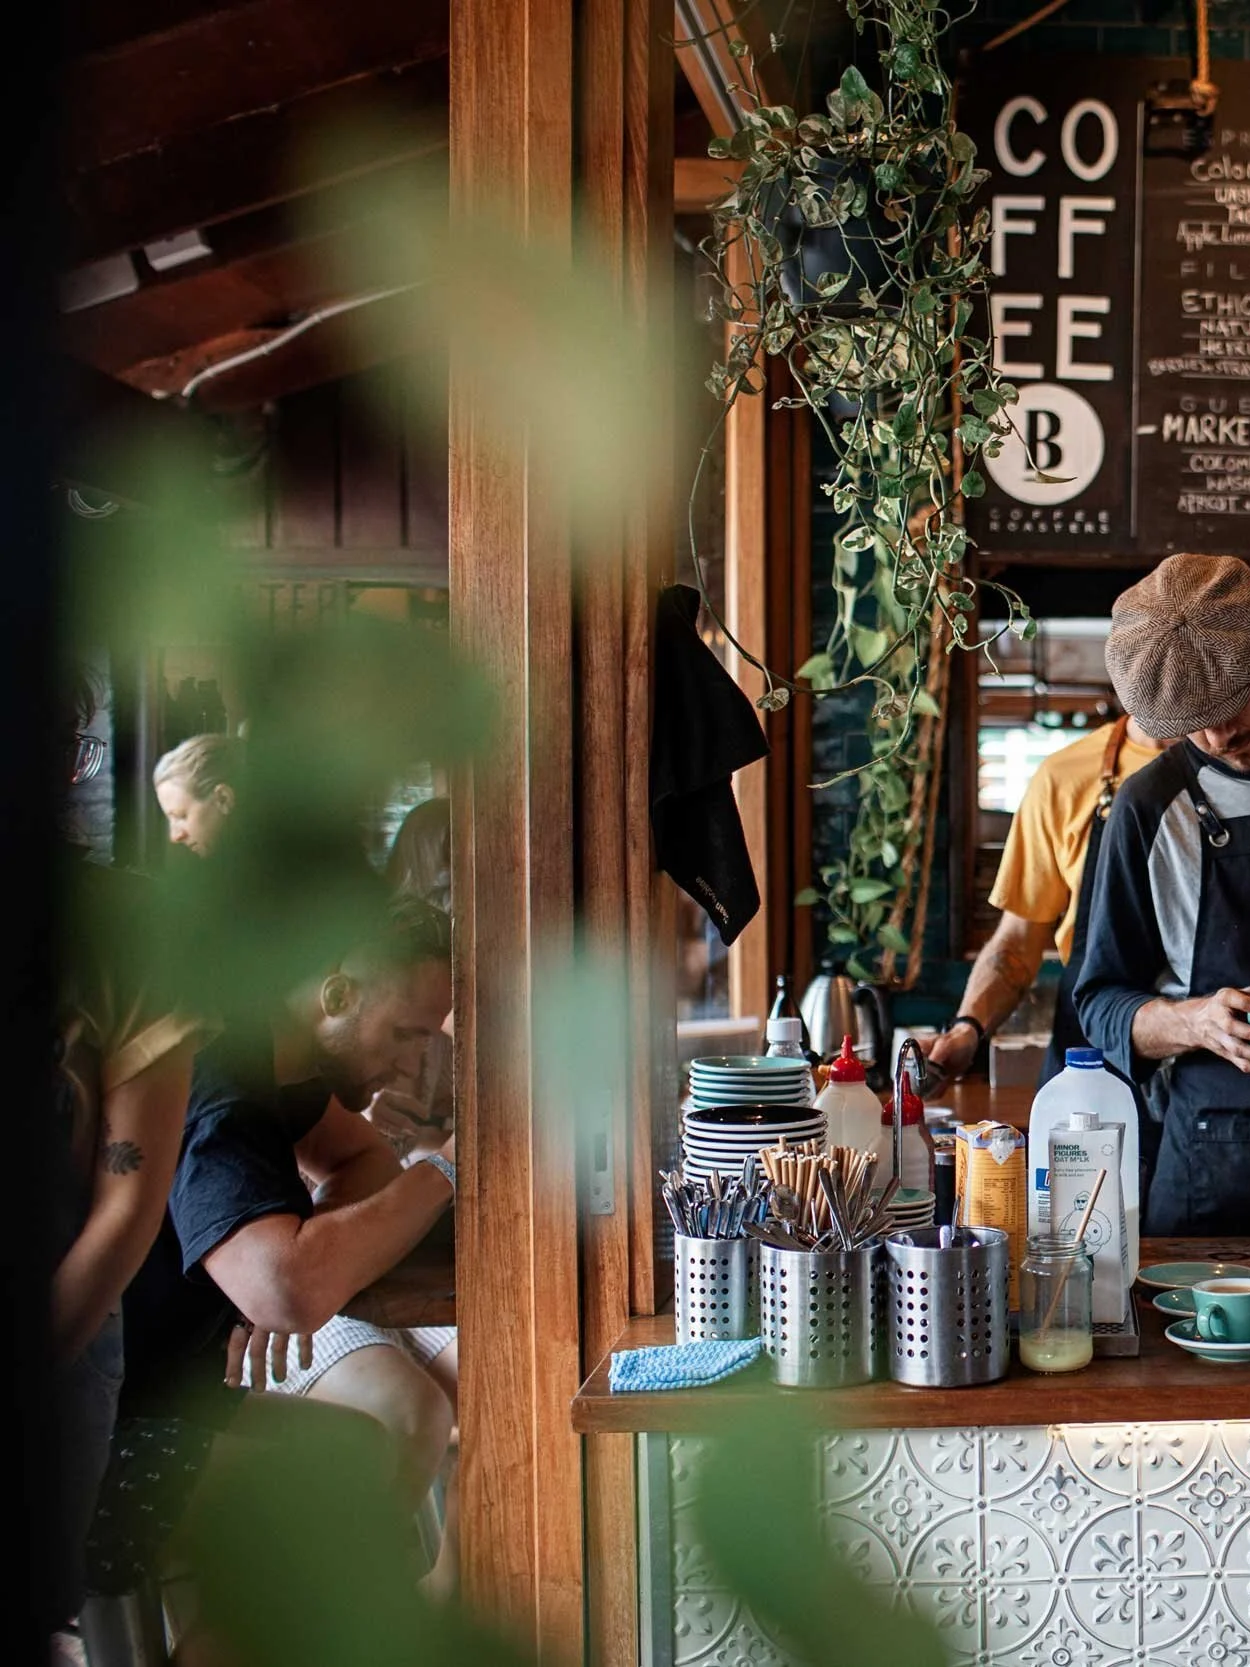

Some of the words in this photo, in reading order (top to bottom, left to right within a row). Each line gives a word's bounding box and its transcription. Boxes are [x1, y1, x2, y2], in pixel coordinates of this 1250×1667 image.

[994, 95, 1119, 182] CO
[991, 195, 1116, 279] FF
[989, 293, 1114, 382] EE
[1024, 408, 1064, 471] B
